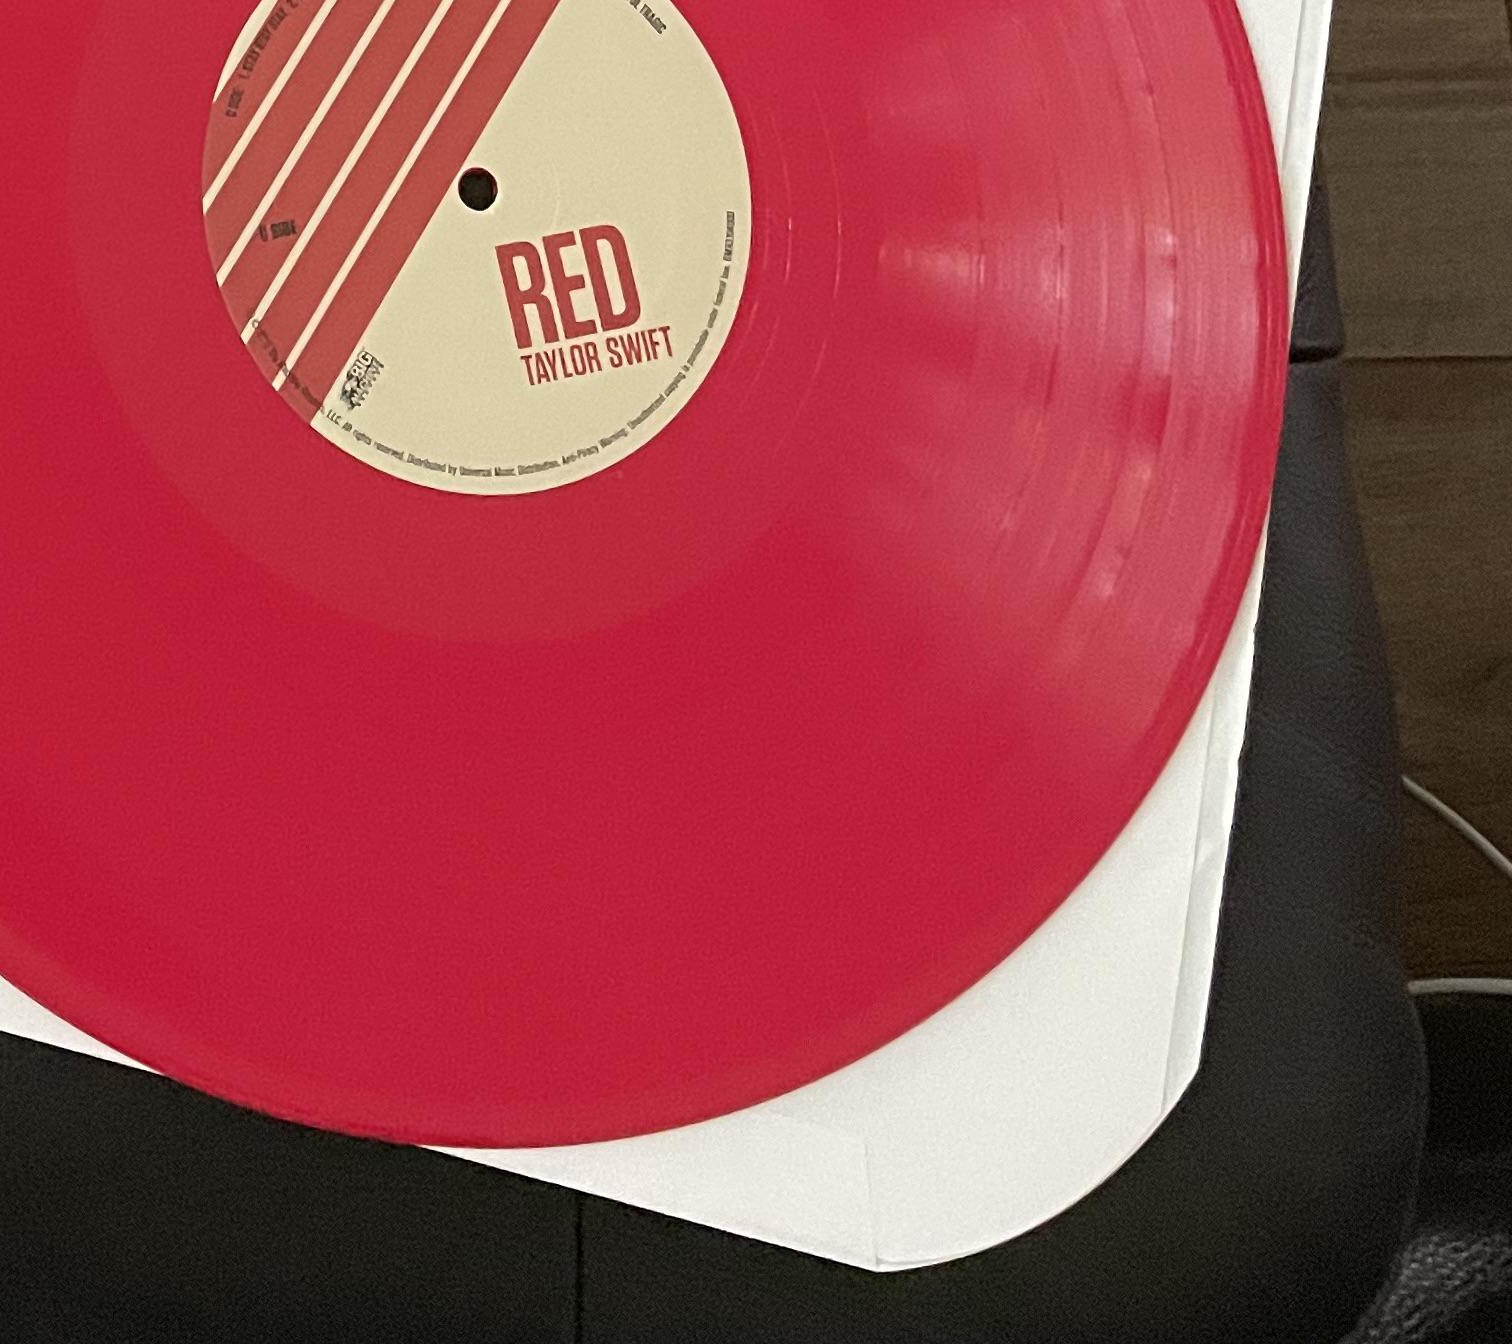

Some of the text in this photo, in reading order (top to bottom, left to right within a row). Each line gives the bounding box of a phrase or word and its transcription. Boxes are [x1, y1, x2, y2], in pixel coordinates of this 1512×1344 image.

[495, 225, 641, 349] RED
[520, 342, 602, 386] TAYLOR
[606, 326, 673, 368] SWIFT
